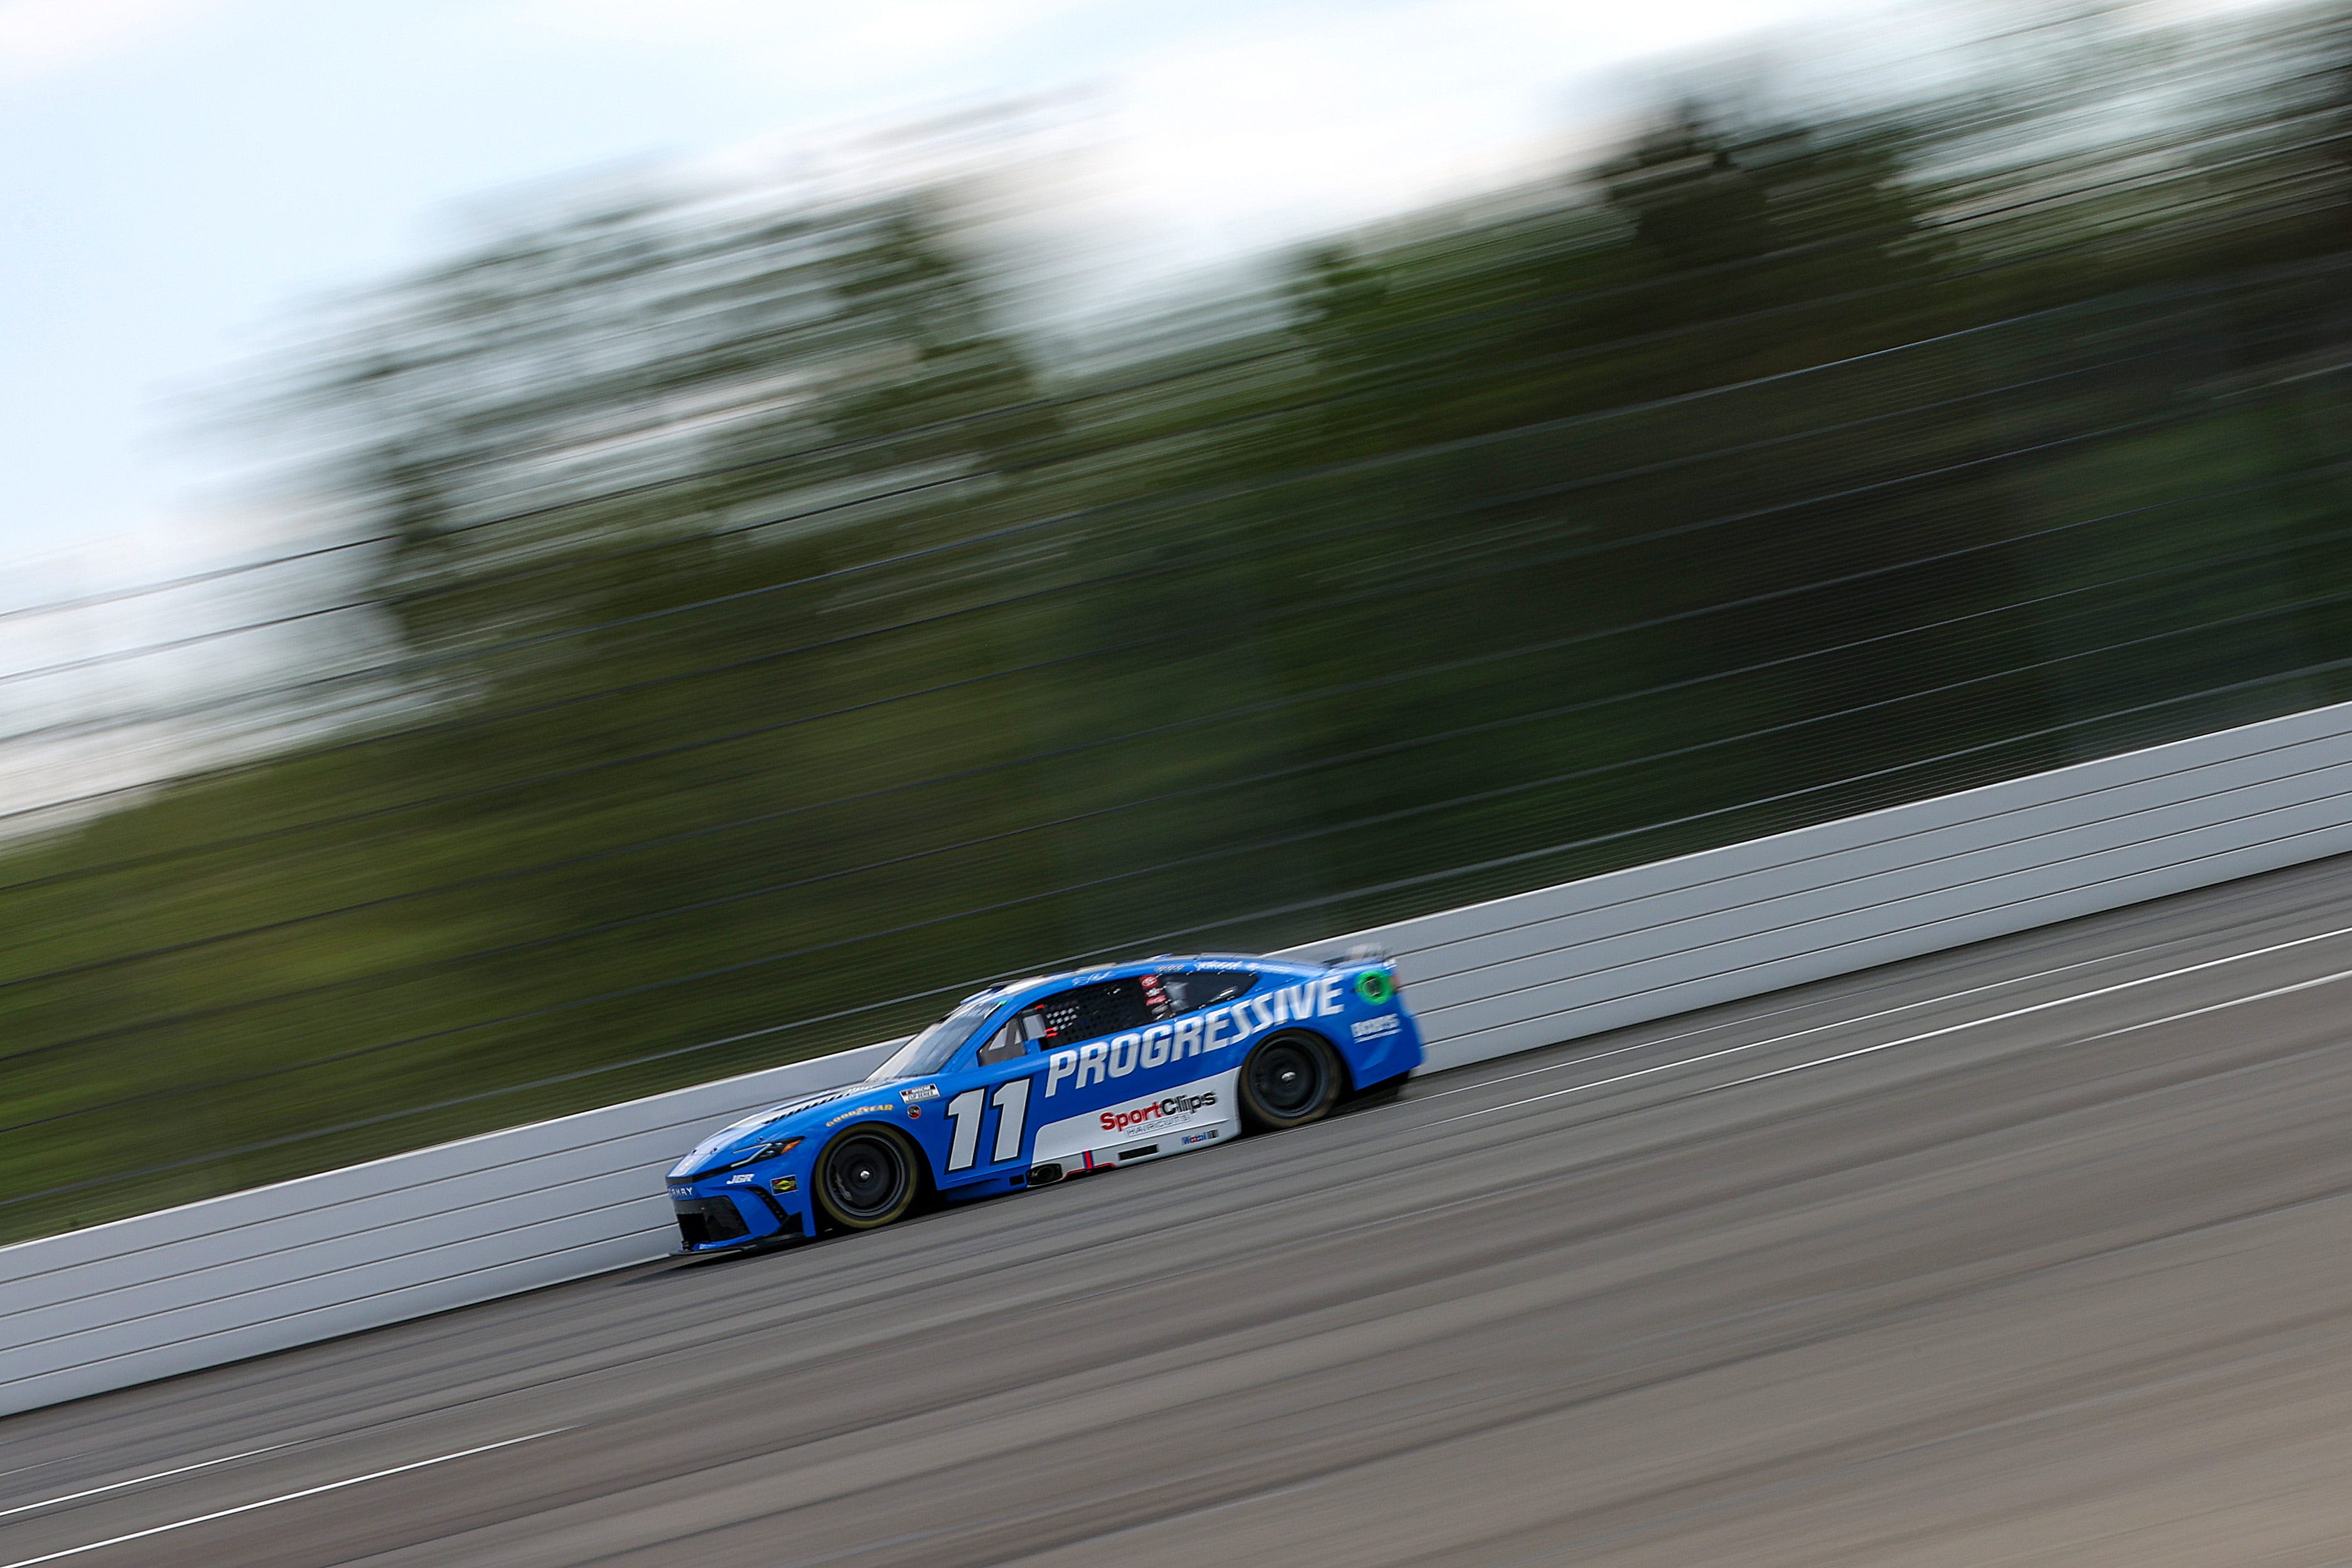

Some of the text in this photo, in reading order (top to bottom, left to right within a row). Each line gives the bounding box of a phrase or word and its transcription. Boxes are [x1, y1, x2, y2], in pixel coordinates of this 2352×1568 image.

[1045, 974, 1345, 1098] PROGRESSIVE
[826, 1104, 894, 1127] GOODYEAR
[946, 1076, 1032, 1173] 11
